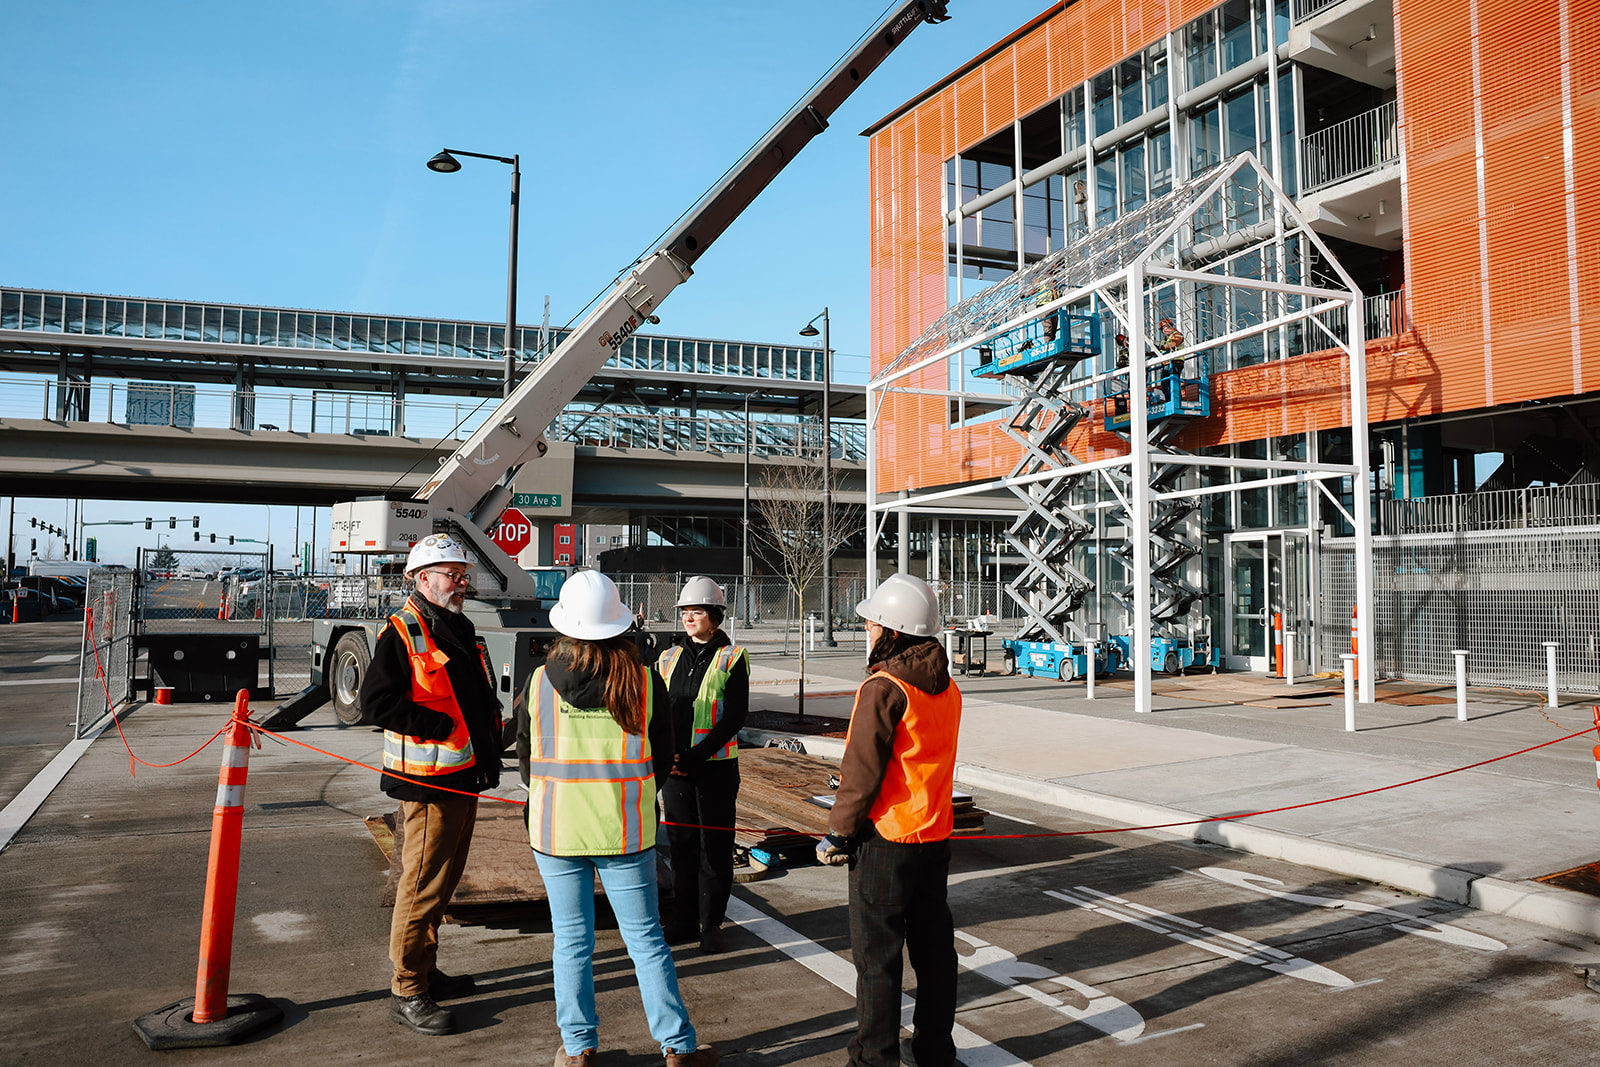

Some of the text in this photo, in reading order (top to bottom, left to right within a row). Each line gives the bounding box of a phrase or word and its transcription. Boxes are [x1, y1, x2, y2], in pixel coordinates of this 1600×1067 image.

[607, 315, 637, 351] 5540F
[1146, 404, 1165, 415] S-3232
[518, 494, 557, 506] 30 Ave S
[395, 508, 428, 519] 5540F
[399, 533, 418, 541] 2048
